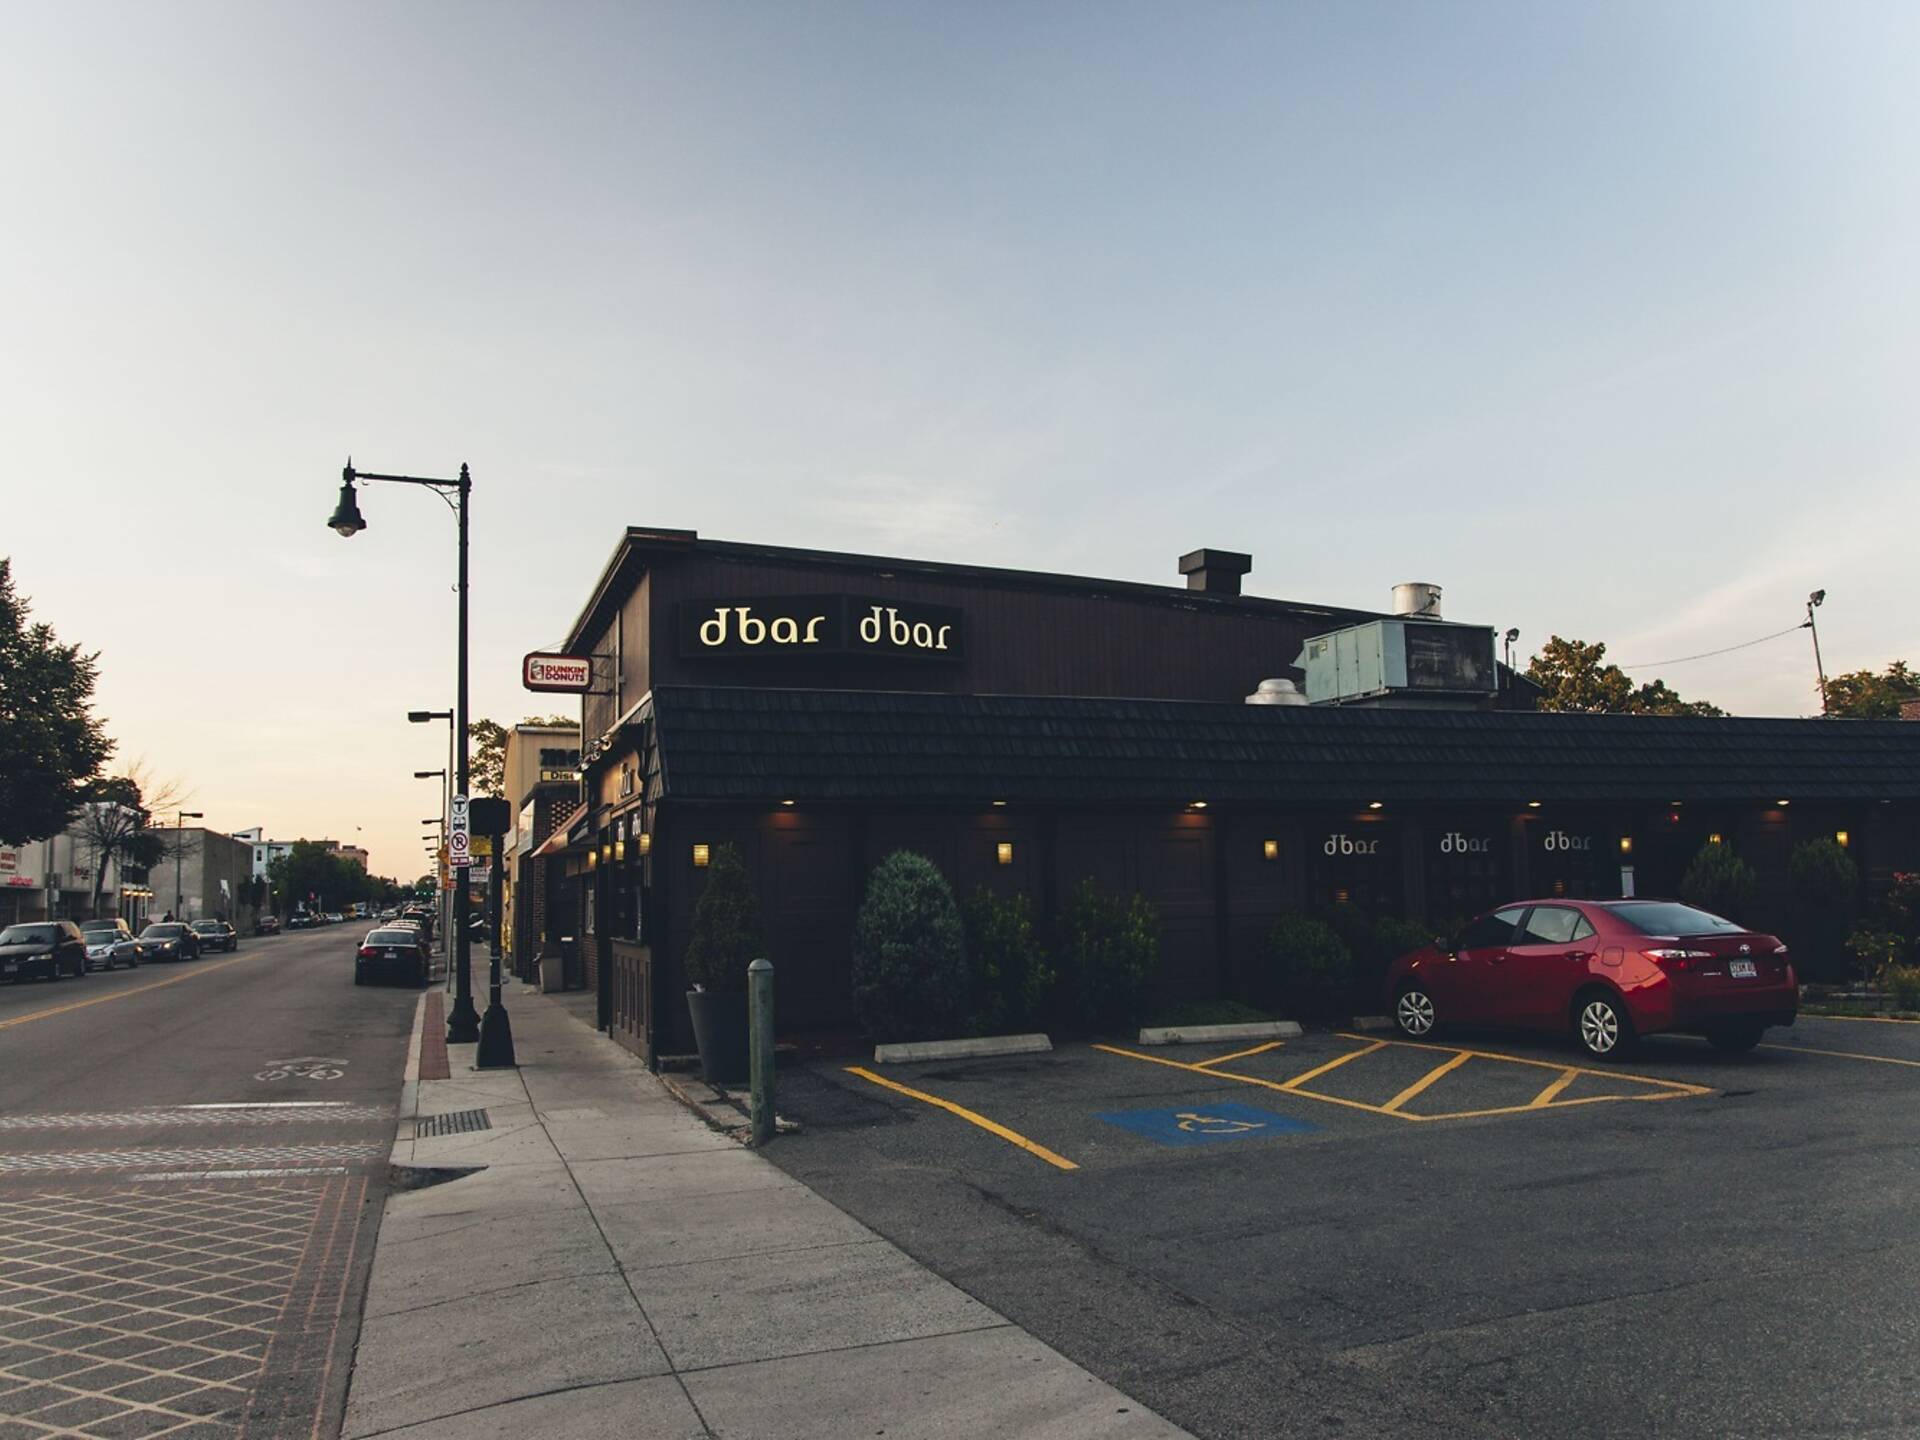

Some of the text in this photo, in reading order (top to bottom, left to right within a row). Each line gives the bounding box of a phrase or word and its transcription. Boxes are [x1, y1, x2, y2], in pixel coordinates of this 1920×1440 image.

[699, 607, 826, 647] dbar
[860, 605, 951, 650] dbar
[545, 672, 585, 682] DONUTS
[1324, 834, 1380, 856] dbar
[1440, 832, 1491, 853] dbar
[1544, 830, 1592, 851] dbar
